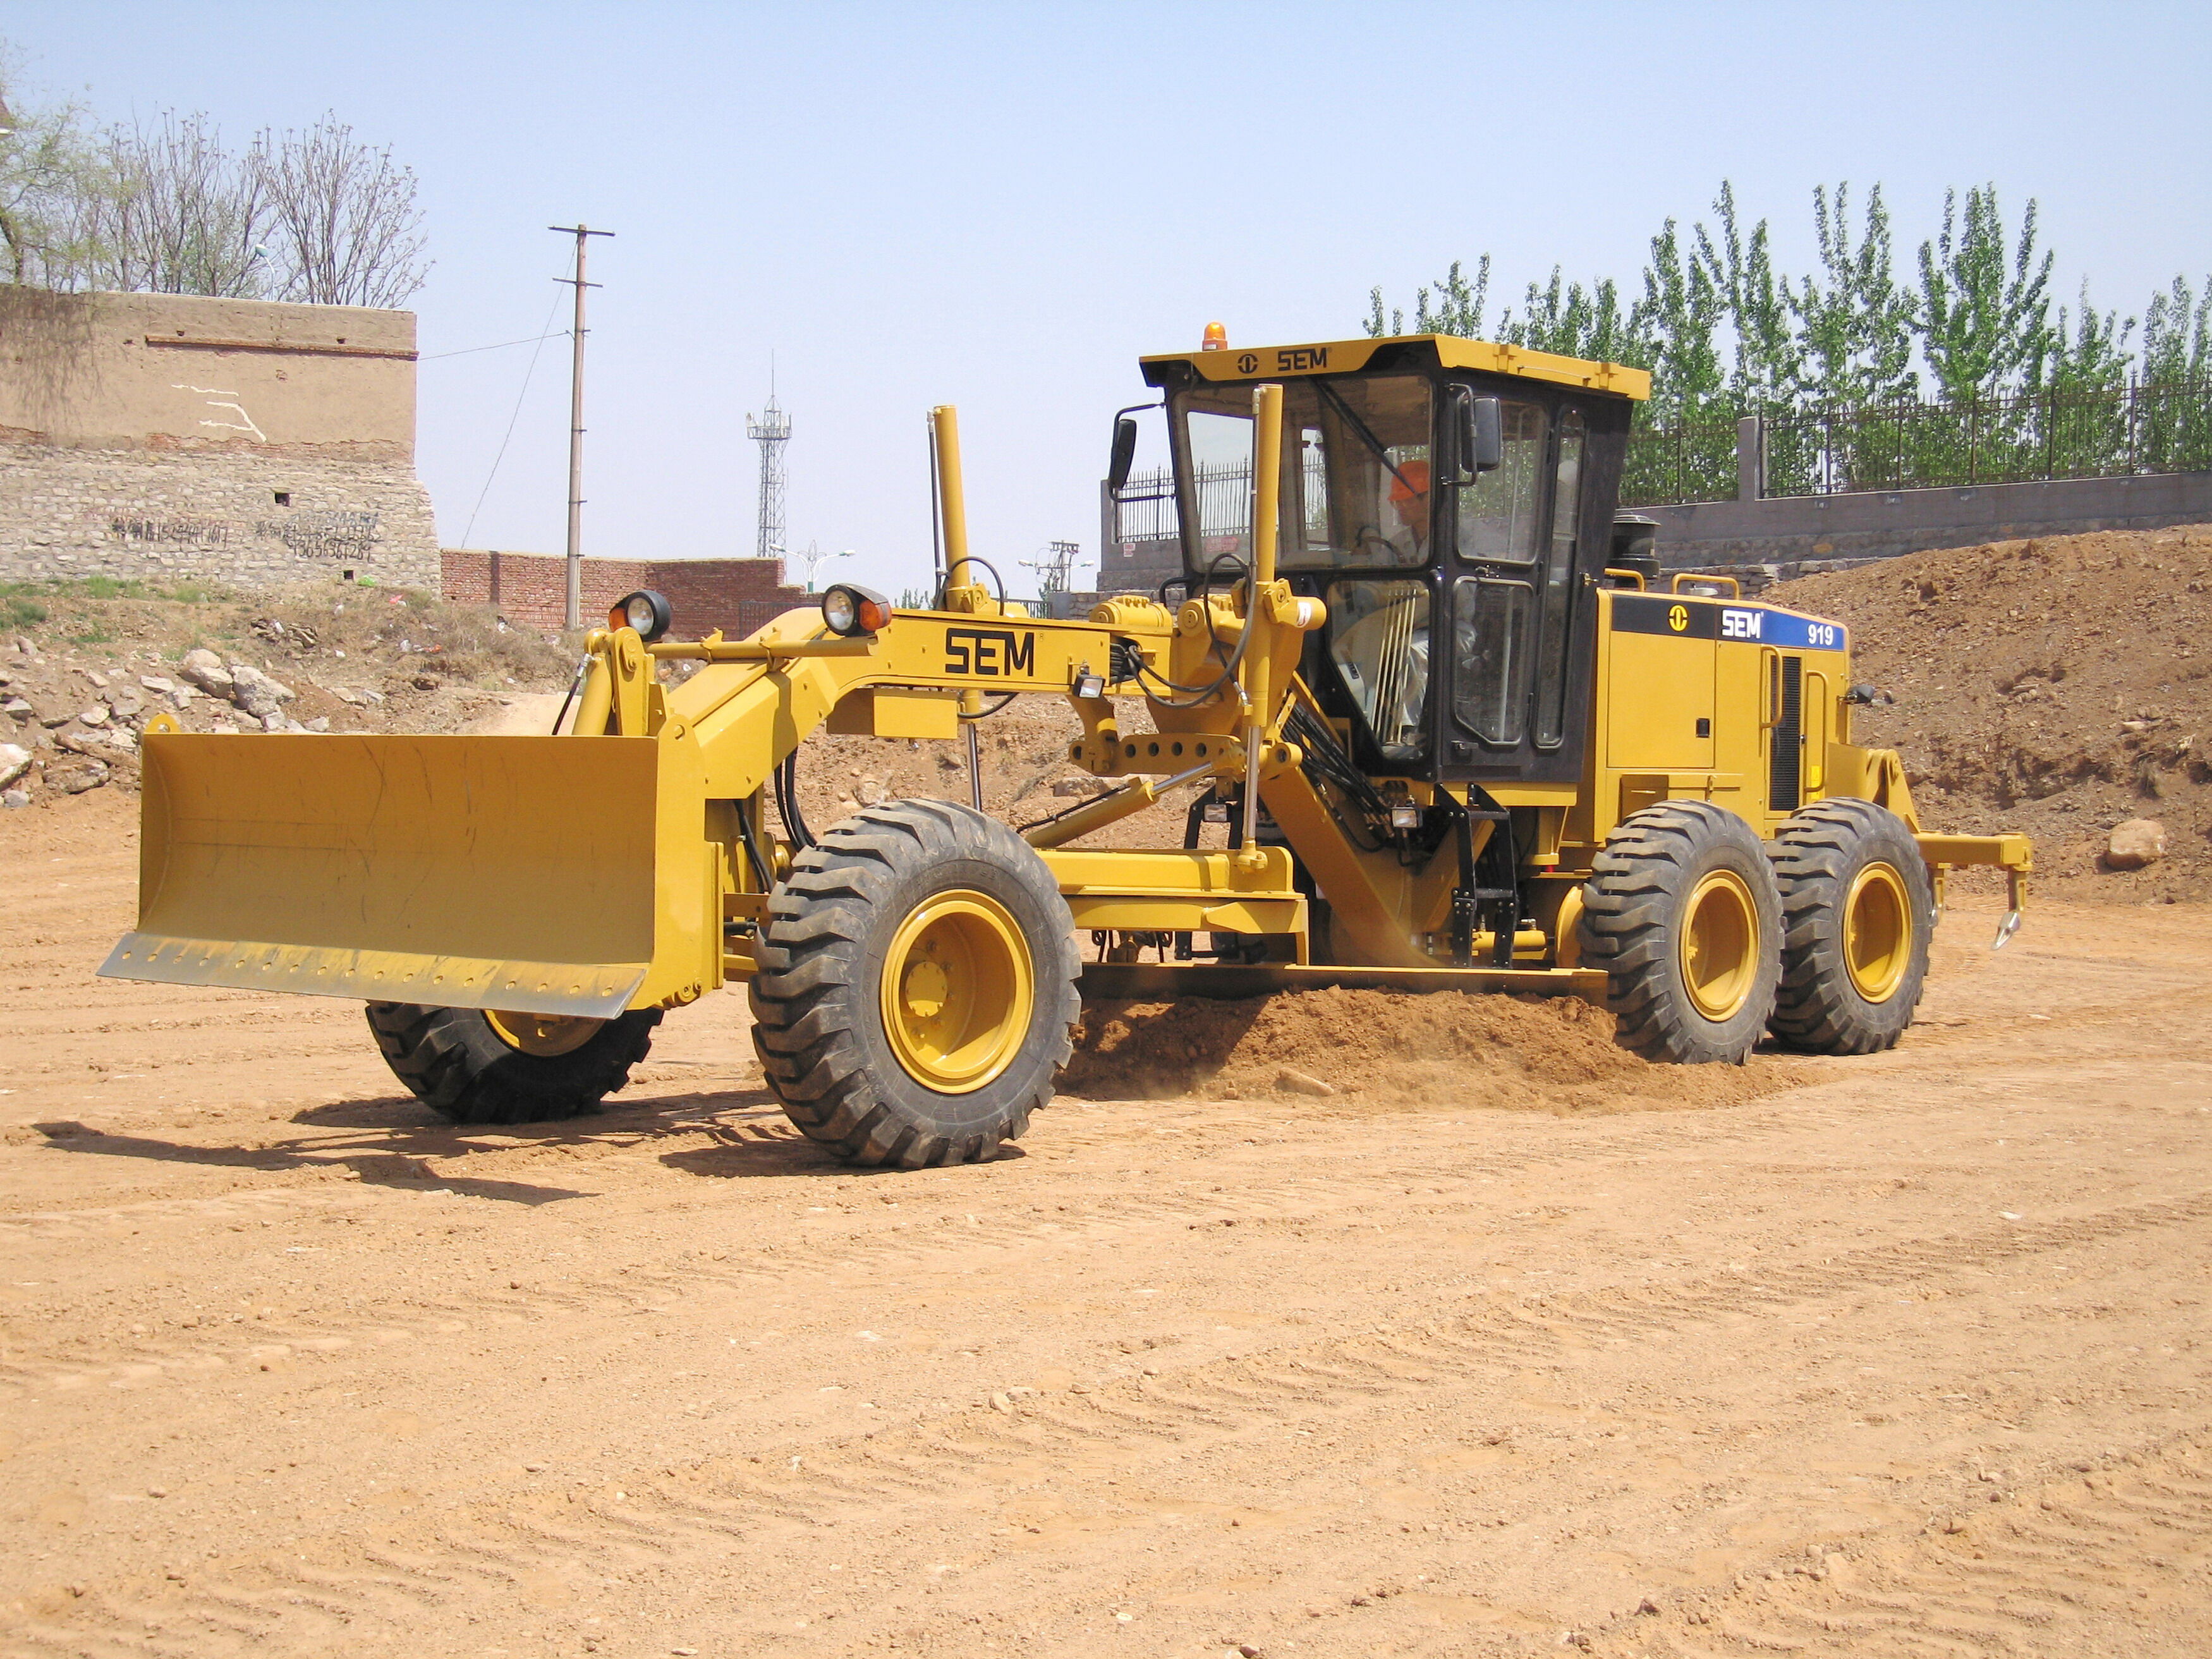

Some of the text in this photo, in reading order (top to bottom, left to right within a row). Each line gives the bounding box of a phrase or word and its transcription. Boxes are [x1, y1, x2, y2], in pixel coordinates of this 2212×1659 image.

[1278, 348, 1327, 371] SEM
[1722, 609, 1761, 638] SEM
[1808, 624, 1833, 645] 919
[945, 628, 1034, 676] SEM
